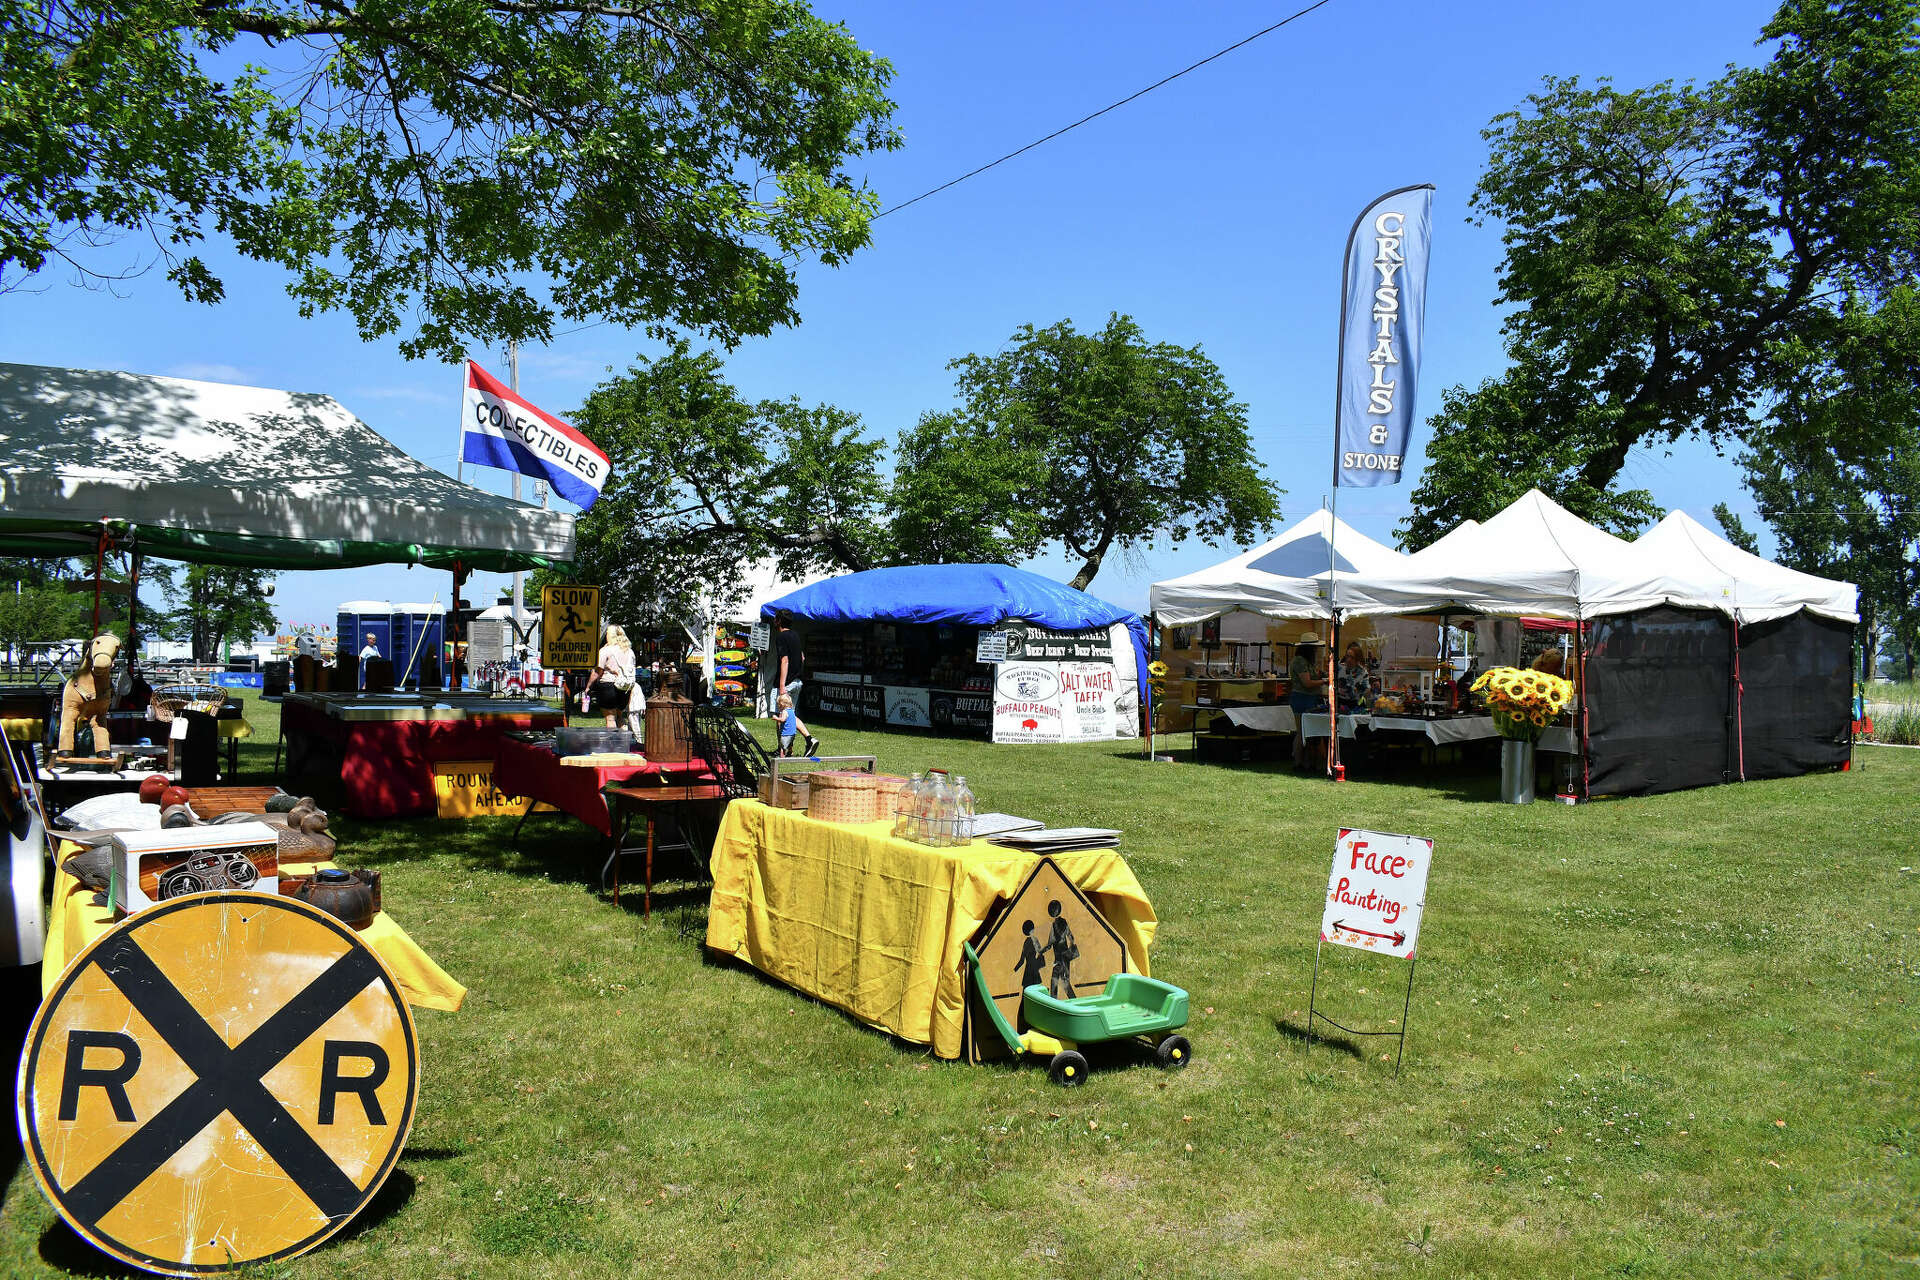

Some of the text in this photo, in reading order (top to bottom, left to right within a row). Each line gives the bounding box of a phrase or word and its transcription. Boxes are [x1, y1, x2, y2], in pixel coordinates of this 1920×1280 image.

[1368, 212, 1405, 414] CRYSTALS
[476, 402, 598, 479] COLECTIBLES
[1369, 425, 1388, 444] &
[1343, 452, 1404, 471] STONE
[551, 590, 593, 606] SLOW
[548, 641, 592, 652] CHILDREN
[551, 653, 589, 663] PLAYING
[1061, 671, 1113, 693] SALT WATER
[856, 689, 879, 703] BLLS
[1074, 691, 1103, 703] TAFFY
[995, 702, 1061, 719] BUFFALO PEANUTS
[476, 792, 523, 807] AHEAD
[1350, 841, 1406, 878] Face
[1334, 877, 1401, 924] Painting
